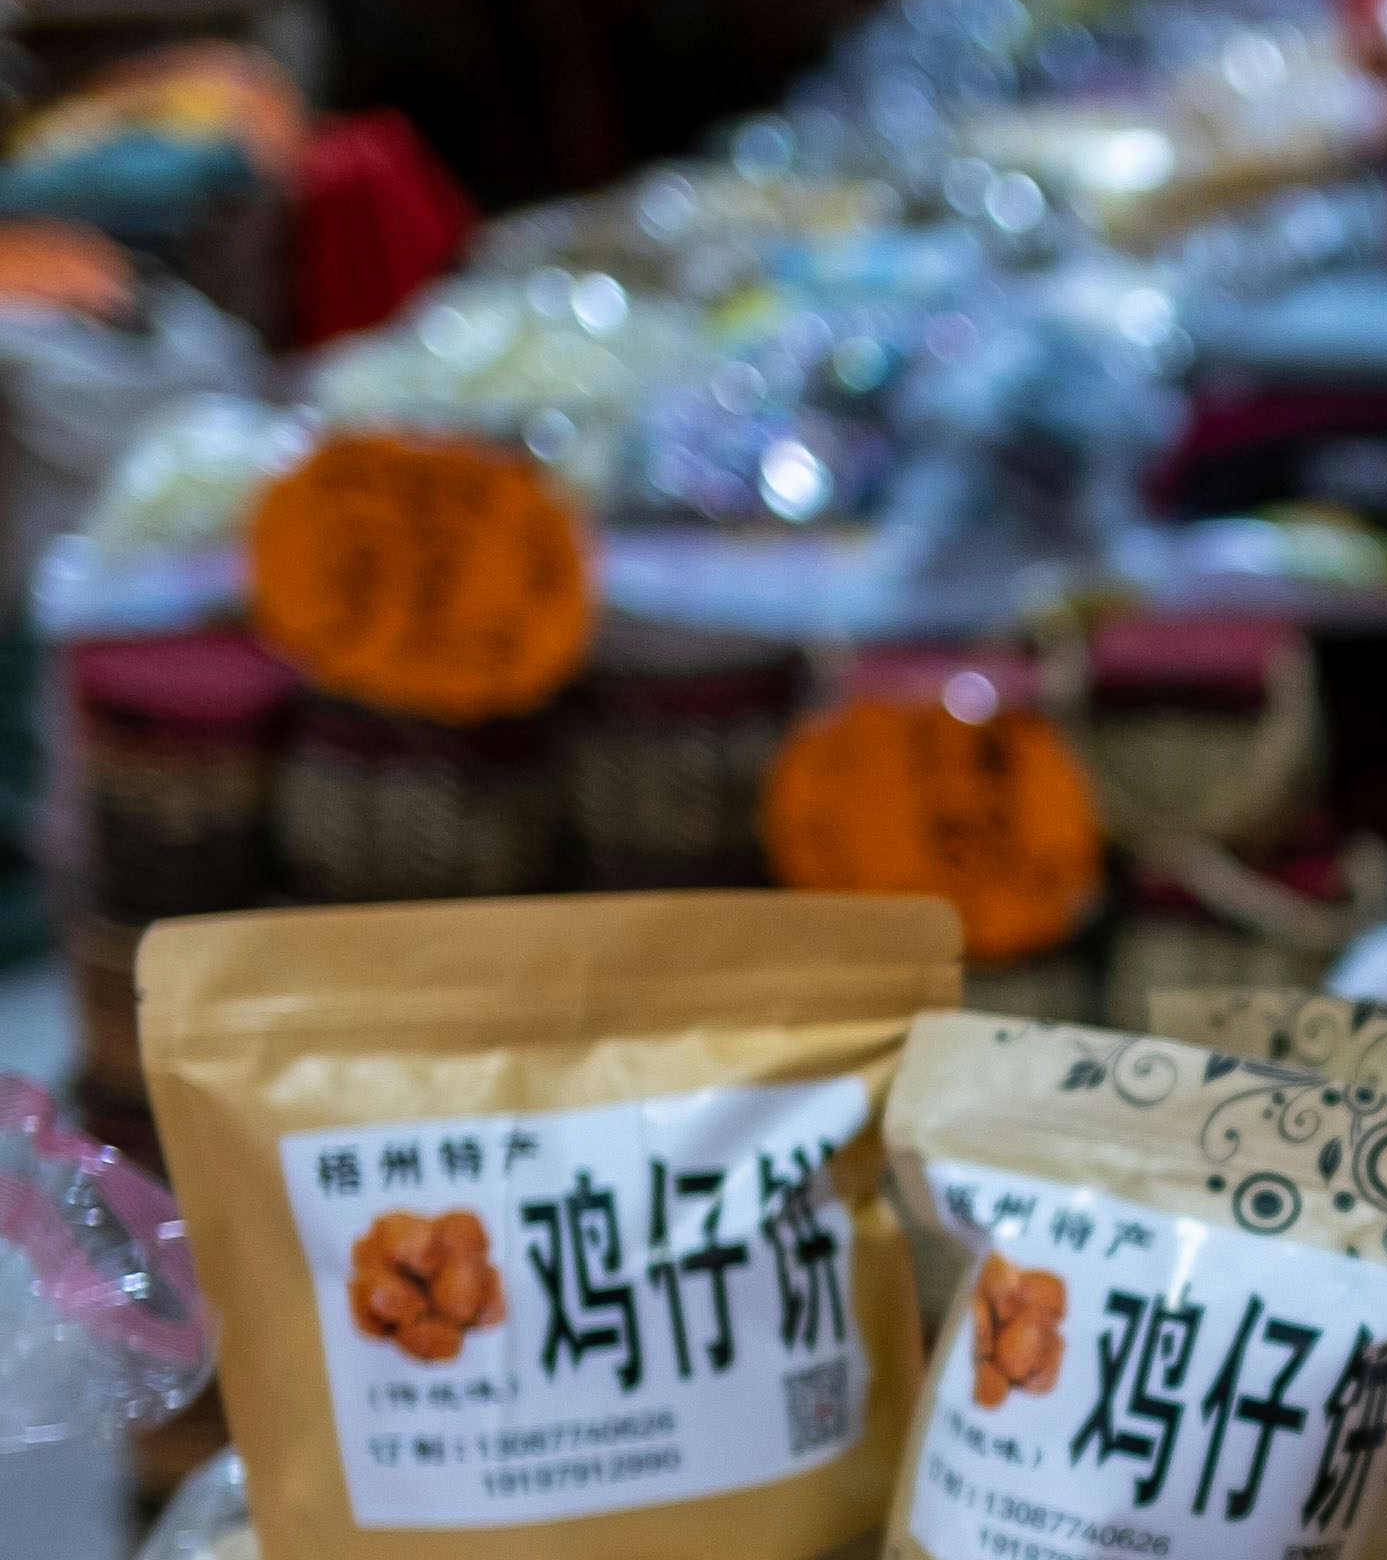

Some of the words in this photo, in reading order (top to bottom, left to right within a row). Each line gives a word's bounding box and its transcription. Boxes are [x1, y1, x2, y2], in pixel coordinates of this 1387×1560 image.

[317, 1130, 541, 1198] 梧州特产
[521, 1138, 848, 1393] 鸡仔饼
